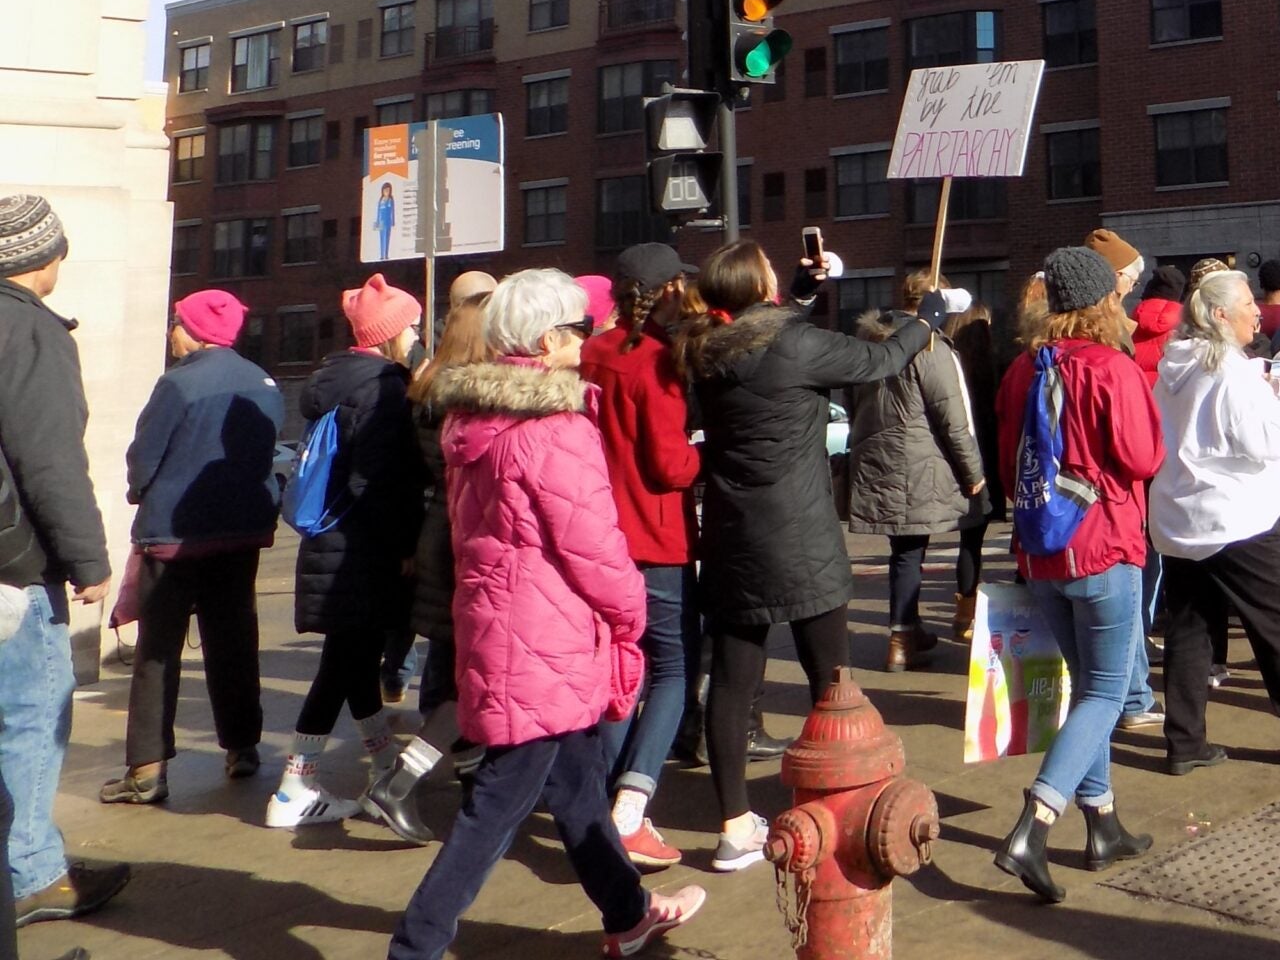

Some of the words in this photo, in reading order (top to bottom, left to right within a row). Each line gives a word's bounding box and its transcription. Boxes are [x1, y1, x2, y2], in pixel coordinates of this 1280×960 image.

[919, 97, 947, 128] by
[960, 86, 1003, 122] the
[446, 137, 481, 151] creening
[898, 129, 1017, 177] PATRIARCHY
